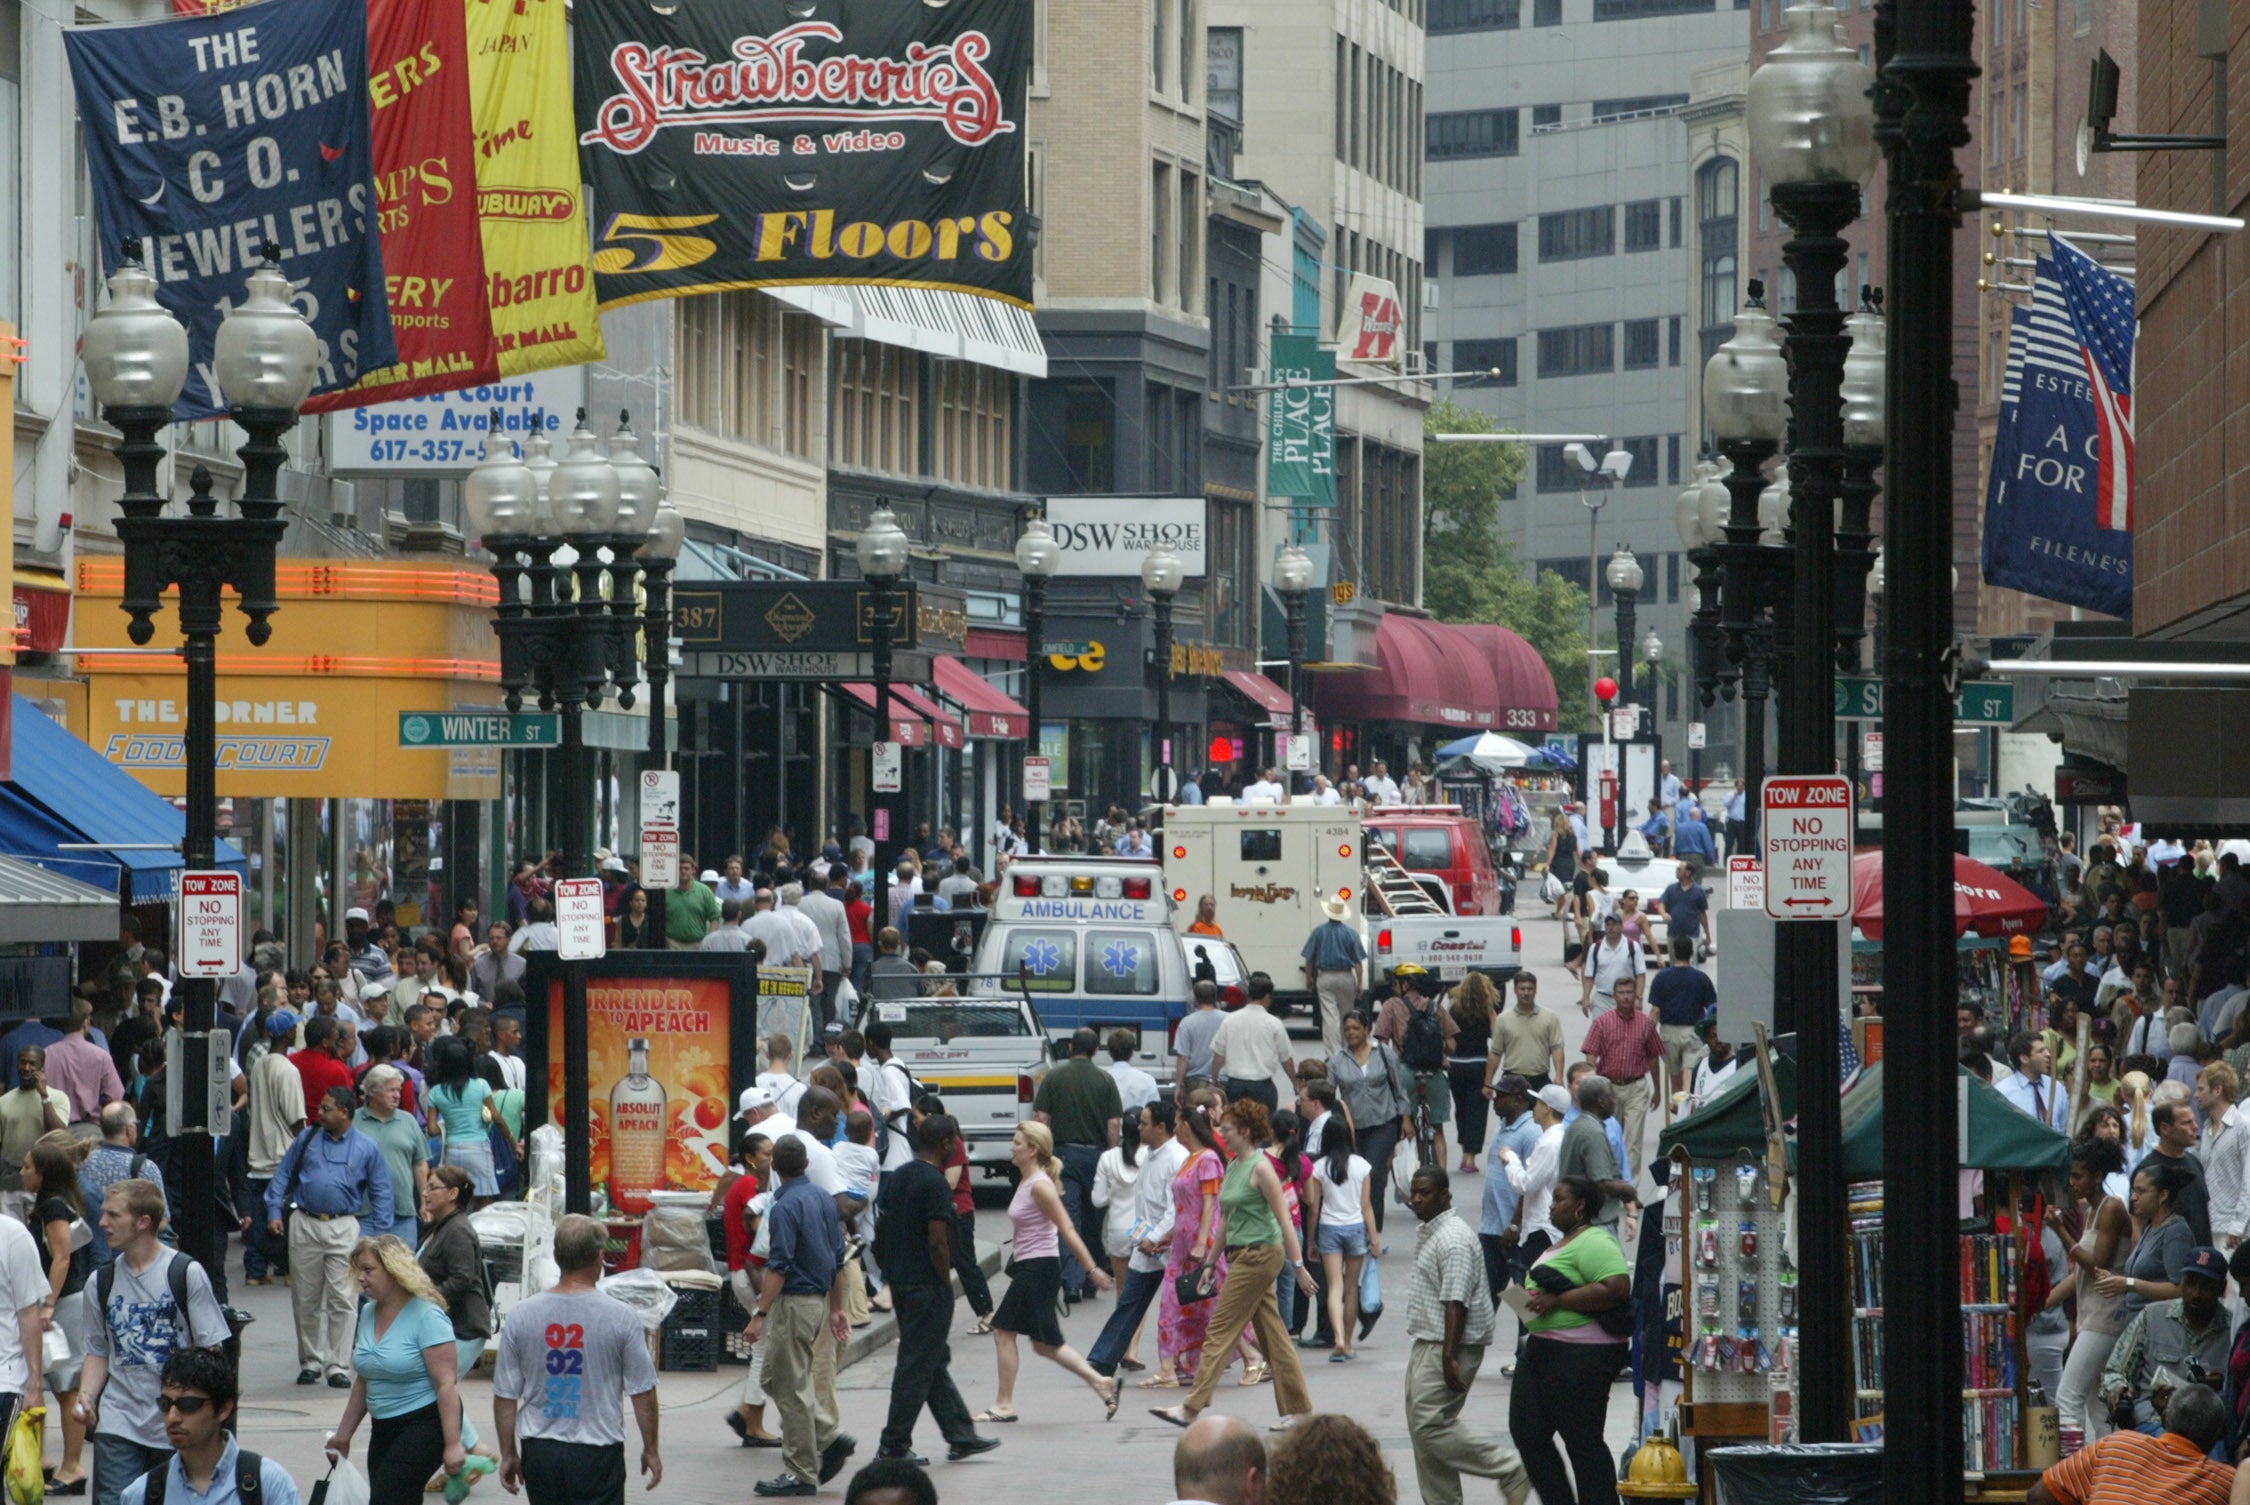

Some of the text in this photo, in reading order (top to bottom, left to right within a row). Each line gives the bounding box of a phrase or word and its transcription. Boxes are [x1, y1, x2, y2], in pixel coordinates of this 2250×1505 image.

[188, 27, 260, 73] THE
[479, 33, 531, 56] JAPAN
[114, 49, 347, 144] E.B. HORN
[580, 22, 1016, 155] Strawberries
[694, 131, 905, 156] Music & Video
[477, 193, 570, 217] UBWAY
[593, 208, 1014, 275] 5 Floors
[484, 264, 585, 309] barro
[518, 321, 577, 350] MALL
[412, 351, 475, 379] MALL
[354, 406, 560, 435] Space Available
[1285, 367, 1310, 463] PLACE
[2045, 424, 2069, 453] A
[1273, 440, 1283, 464] THE
[2017, 453, 2085, 494] FOR
[1053, 522, 1200, 551] DSW SHOE
[2030, 536, 2128, 575] FILENE'S
[676, 607, 717, 628] 387
[863, 607, 903, 627] 37
[717, 654, 837, 674] DSW SHOE
[775, 664, 837, 674] WAREHOUSE
[115, 699, 318, 724] THE ORNER
[1506, 709, 1537, 727] 333
[1983, 699, 2002, 718] ST
[441, 716, 541, 741] WINTER ST
[1767, 787, 1846, 804] TOW ZONE
[1793, 817, 1823, 835] NO
[1770, 839, 1847, 852] STOPPING
[1732, 861, 1748, 869] TOW
[1792, 858, 1823, 870] ANY
[185, 880, 206, 891] TOW
[210, 880, 237, 891] ZONE
[1743, 875, 1759, 883] NO
[1790, 877, 1827, 889] TIME
[559, 883, 600, 896] TOW ZONE
[199, 900, 222, 914] NO
[572, 900, 588, 910] NO
[1021, 901, 1145, 920] AMBULANCE
[186, 915, 235, 925] STOPPING
[561, 913, 600, 922] STOPPING
[199, 938, 222, 947] TIME
[200, 928, 221, 937] ANY
[573, 935, 591, 943] TIME
[981, 977, 993, 988] 78
[609, 1012, 709, 1033] TO APEACH
[616, 1102, 661, 1114] ABSOLUT
[619, 1119, 658, 1131] APEACH
[545, 1323, 584, 1348] 02
[546, 1349, 583, 1375] 02
